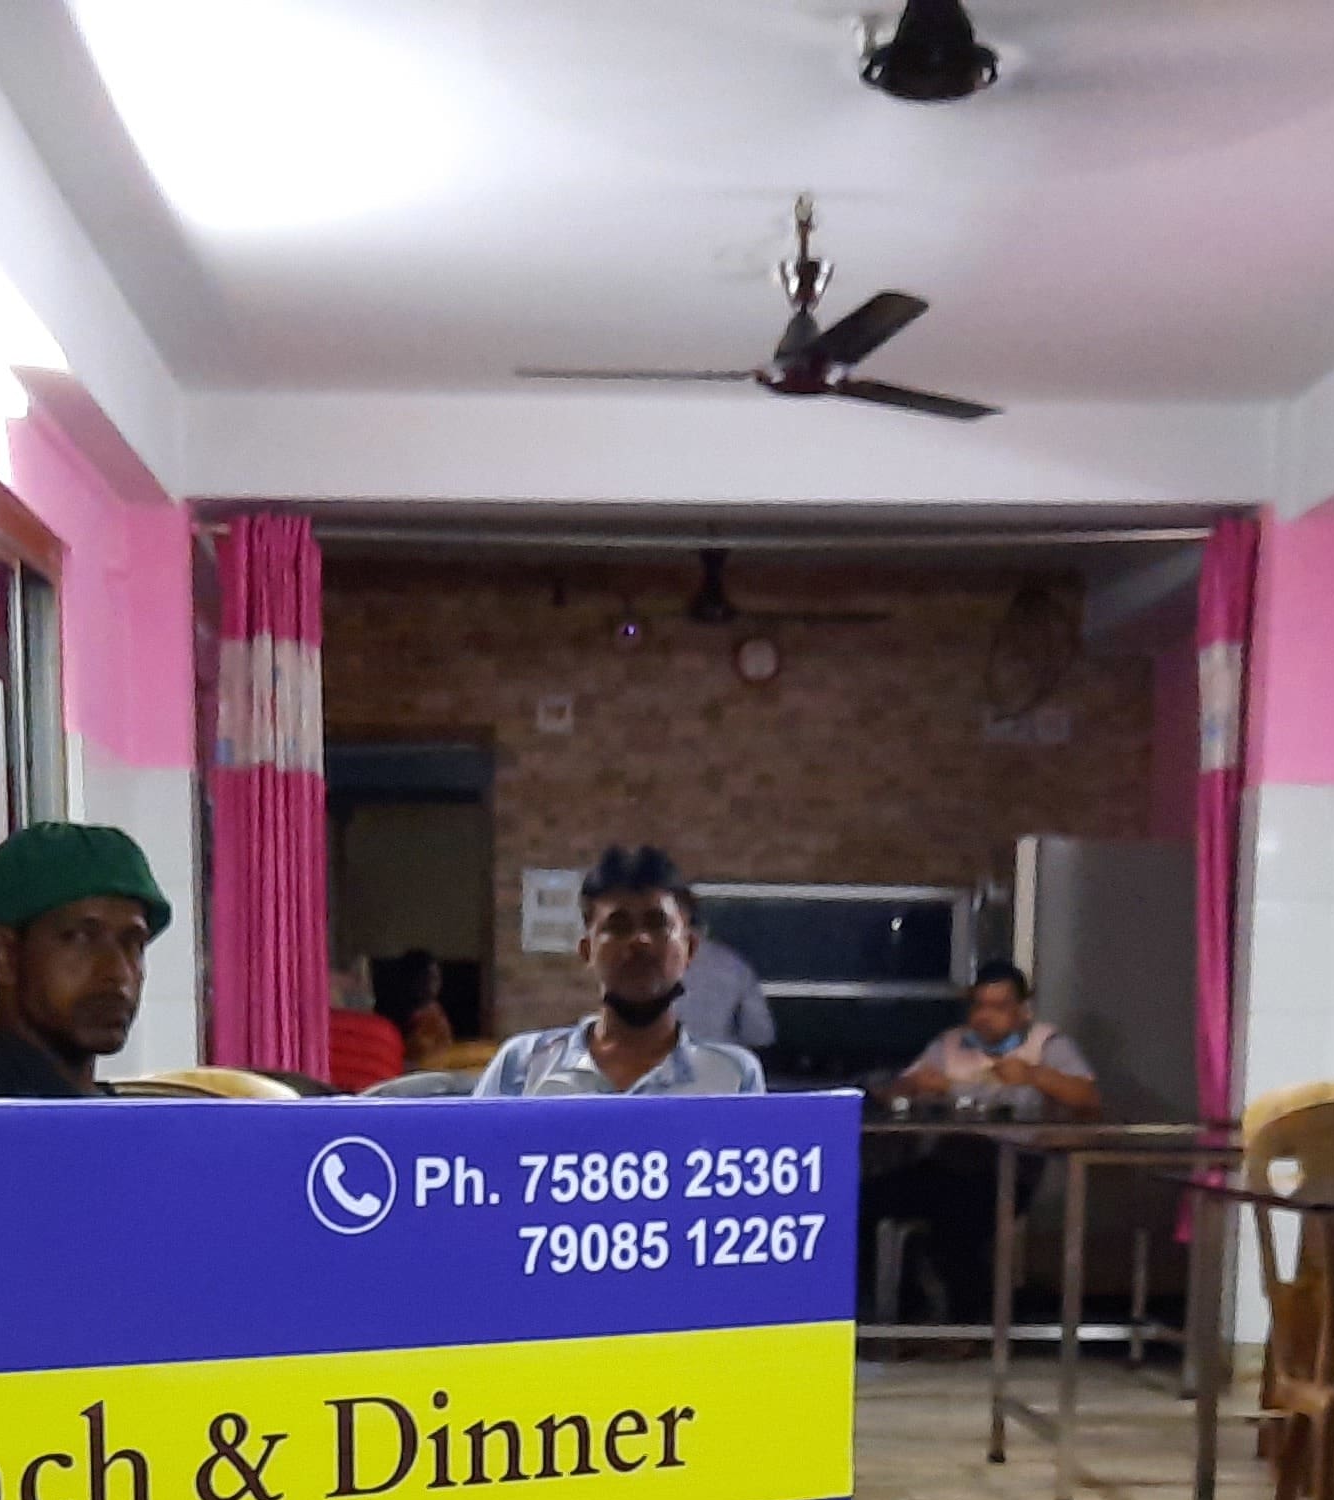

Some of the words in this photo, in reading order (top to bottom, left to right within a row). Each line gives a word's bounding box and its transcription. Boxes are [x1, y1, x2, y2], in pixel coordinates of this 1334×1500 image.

[415, 1155, 501, 1208] Ph.
[519, 1149, 670, 1204] 75868
[684, 1145, 823, 1199] 25361
[519, 1220, 670, 1275] 79085
[685, 1213, 827, 1267] 12267
[324, 1391, 696, 1499] Dinner
